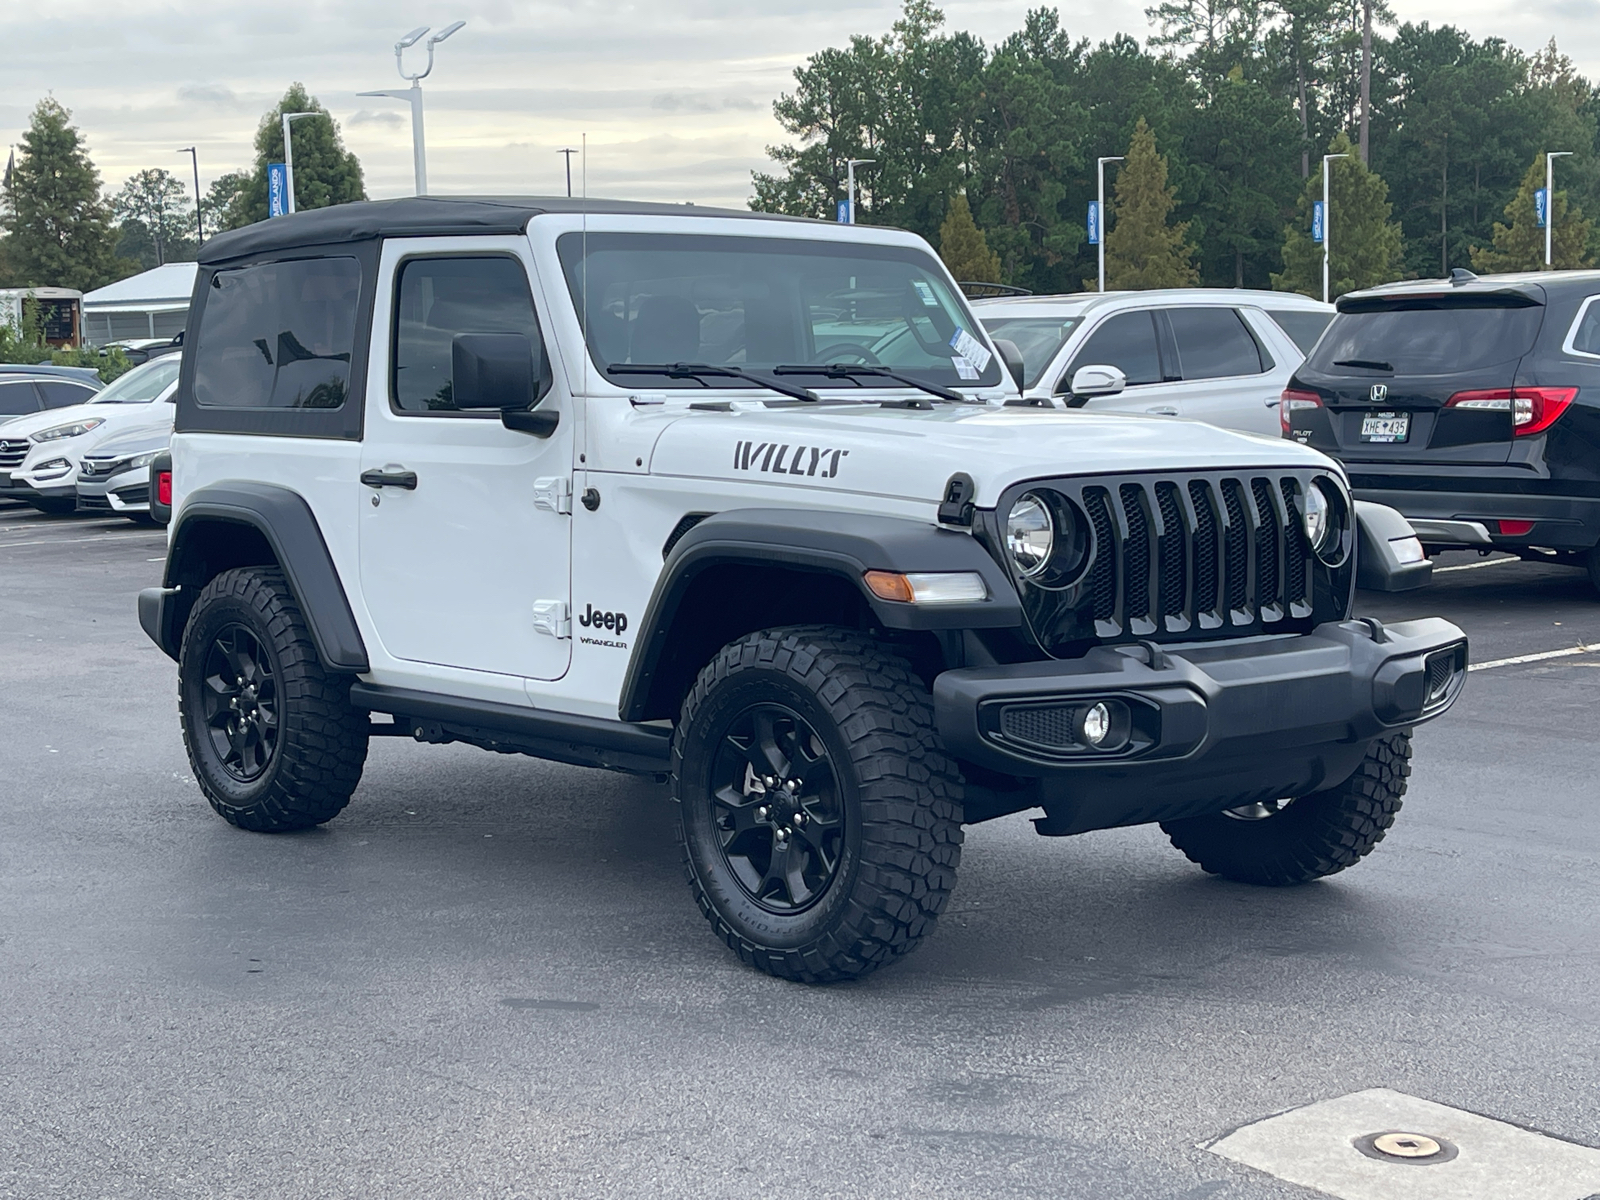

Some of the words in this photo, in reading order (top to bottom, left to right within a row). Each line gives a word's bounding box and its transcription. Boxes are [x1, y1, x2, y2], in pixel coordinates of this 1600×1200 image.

[1292, 429, 1314, 437] PILOT
[1363, 421, 1382, 434] XHE
[1388, 421, 1406, 434] 435
[733, 440, 850, 478] WILLYS
[578, 603, 628, 636] Jeep
[579, 636, 628, 650] WRANGLER
